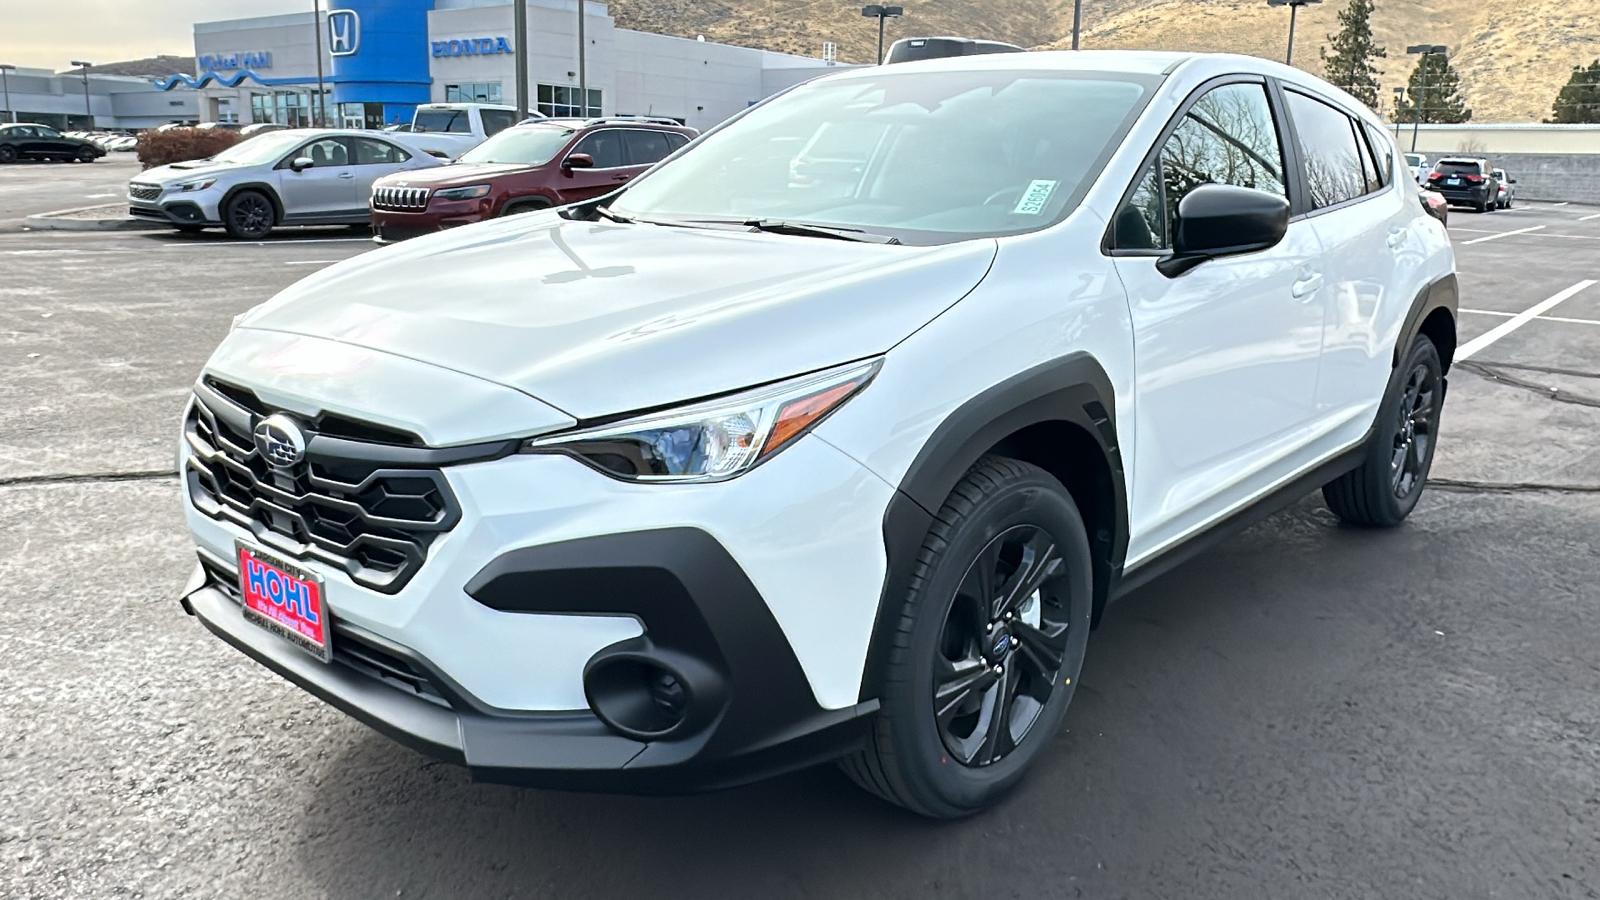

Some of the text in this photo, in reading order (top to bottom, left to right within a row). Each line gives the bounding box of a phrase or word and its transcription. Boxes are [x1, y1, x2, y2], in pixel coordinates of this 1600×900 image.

[431, 37, 512, 58] HONDA
[1021, 184, 1052, 212] S26054
[284, 561, 300, 577] CITY
[247, 559, 319, 624] HOHL
[243, 609, 326, 659] MICHAEL HOHL AUTOMOTIVE
